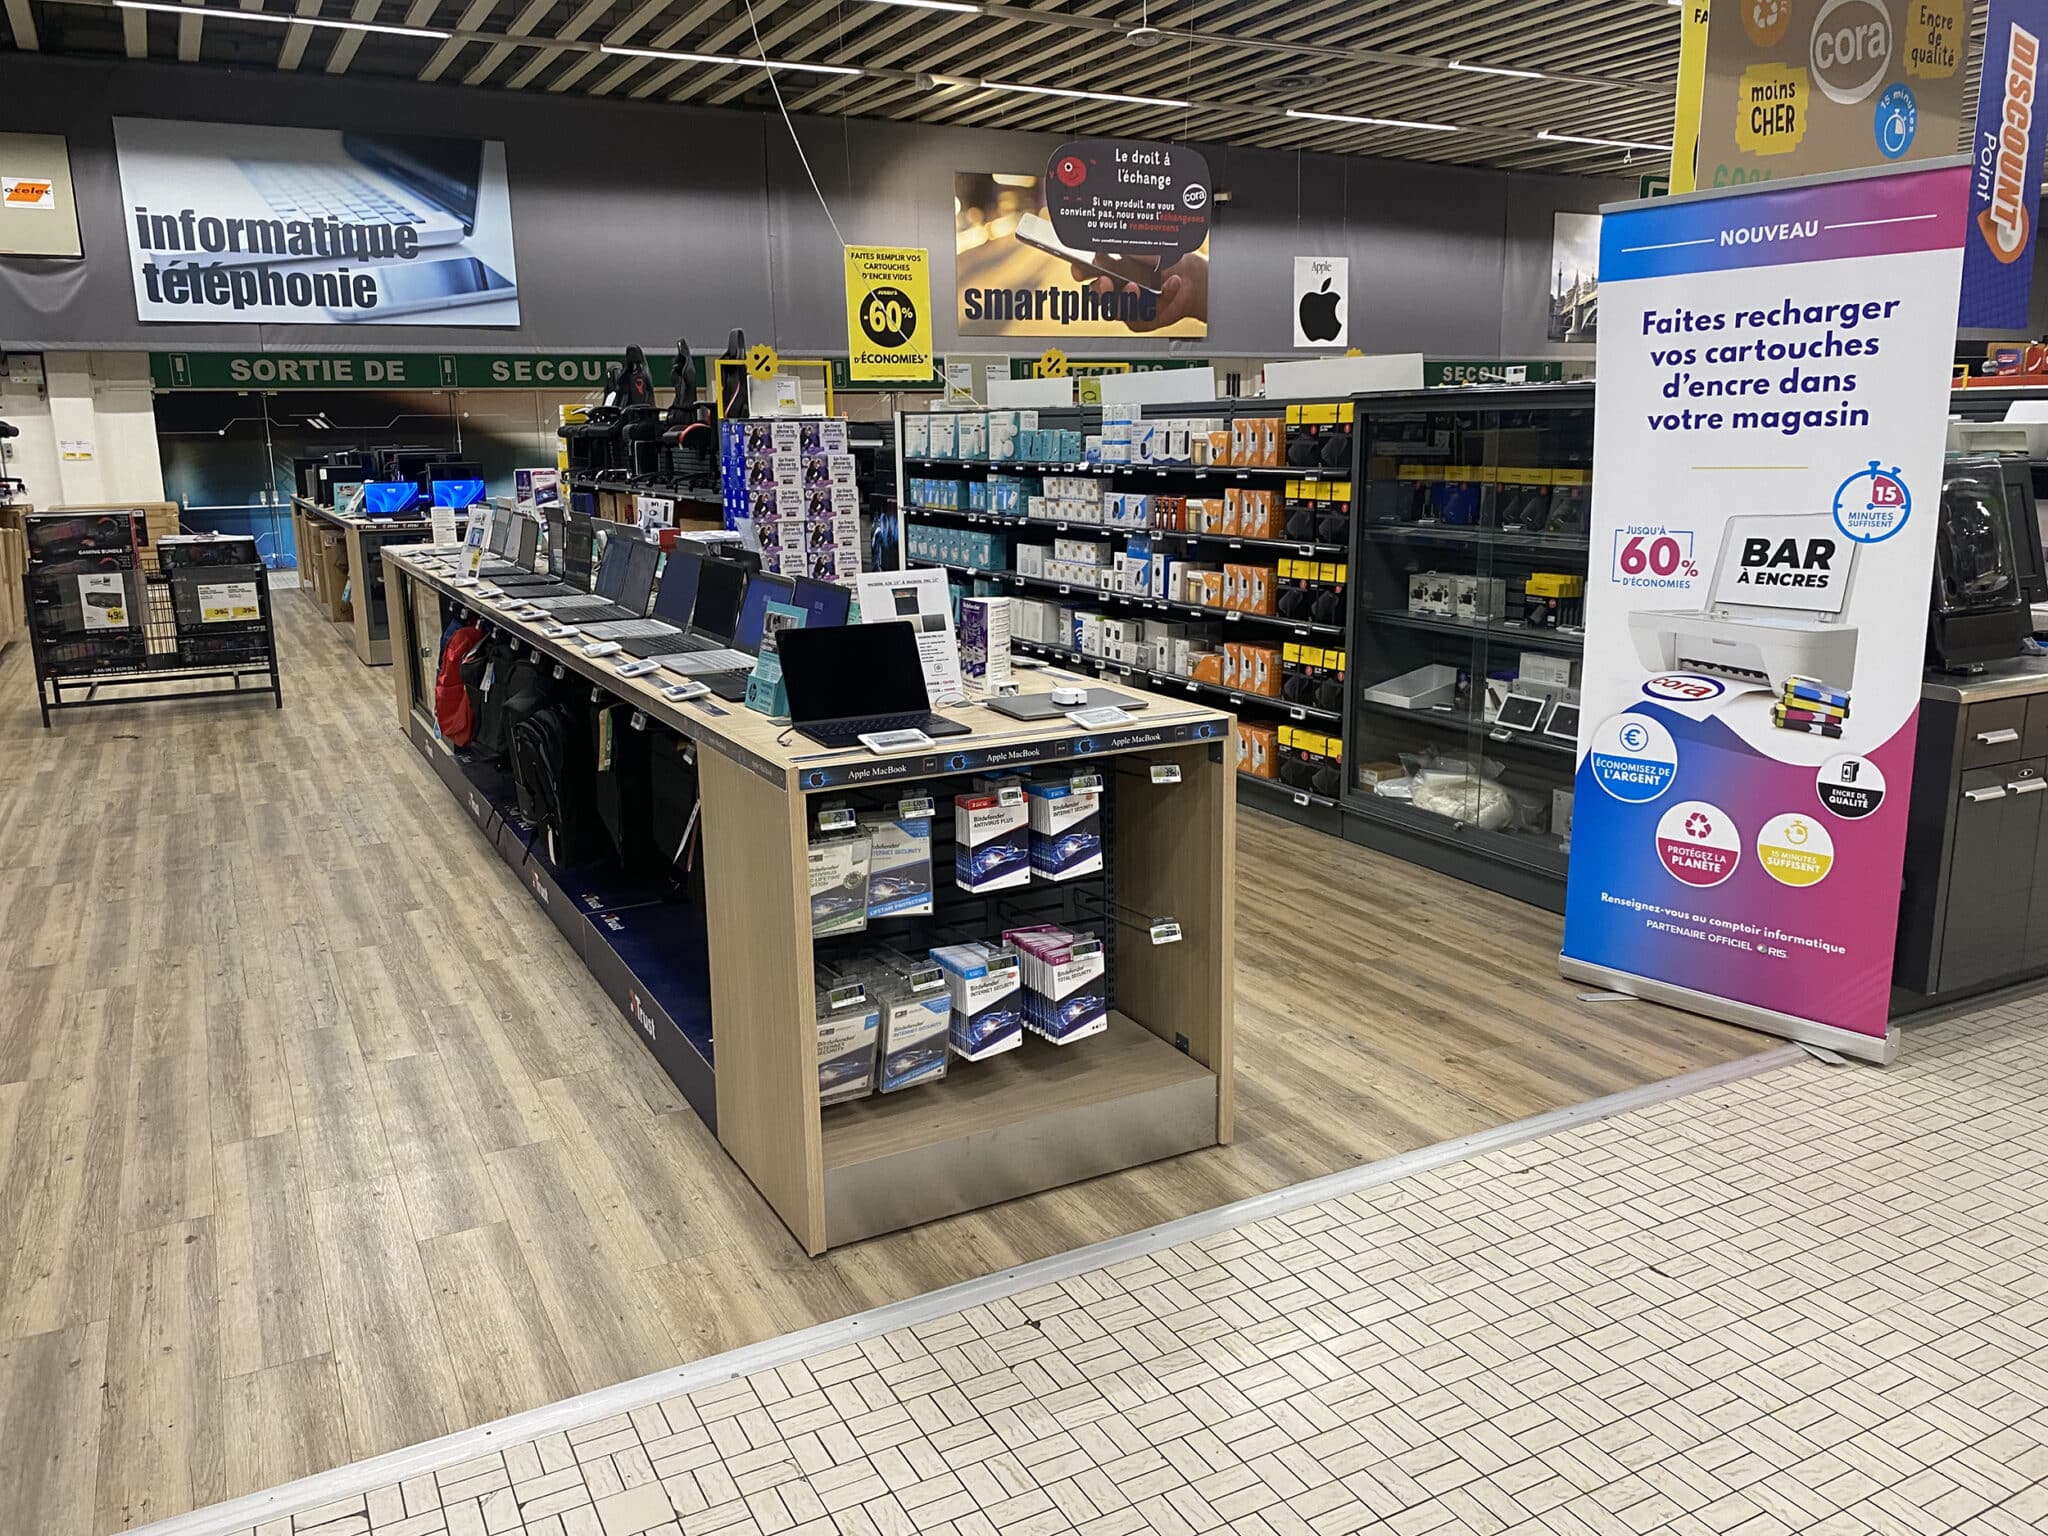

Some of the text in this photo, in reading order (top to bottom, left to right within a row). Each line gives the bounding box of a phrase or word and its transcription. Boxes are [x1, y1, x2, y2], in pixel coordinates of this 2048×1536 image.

[1919, 4, 1953, 30] Encre
[1814, 21, 1887, 69] cora
[1928, 27, 1942, 45] de
[1911, 44, 1955, 68] qualité
[1751, 80, 1796, 102] moins
[1751, 103, 1796, 136] CHER
[1993, 31, 2037, 232] DISCOUNT
[1115, 148, 1128, 162] Le
[1132, 149, 1161, 165] droit
[1976, 131, 1997, 201] Point
[1117, 169, 1172, 190] l'échange
[1092, 196, 1175, 211] Si un produit ne vous
[1060, 207, 1096, 217] convient
[1116, 210, 1134, 220] nous
[1136, 212, 1154, 221] vous
[1087, 220, 1098, 228] ou
[1099, 220, 1118, 229] vous
[1119, 220, 1127, 229] le
[1719, 220, 1819, 247] NOUVEAU
[135, 206, 420, 262] informatique
[851, 252, 921, 262] FAITES REMPLIR VOS
[863, 263, 910, 272] CARTOUCHES
[1311, 259, 1333, 274] Apple
[142, 261, 378, 311] téléphonie
[892, 273, 913, 281] VIDES
[964, 284, 1158, 325] smartphone
[1641, 298, 1901, 336] Faites recharger
[1650, 330, 1881, 367] vos cartouches
[230, 358, 626, 381] SORTIE DE SECOU
[1442, 366, 1508, 382] SECOU
[1662, 366, 1857, 399] d'encre dans
[1647, 401, 1870, 436] votre magasin
[1875, 485, 1897, 502] 15
[1847, 519, 1892, 528] SUFFISENT
[1848, 511, 1894, 521] MINUTES
[1625, 525, 1667, 536] JUSQU'À
[1619, 537, 1699, 577] 60%
[1740, 537, 1836, 570] BAR
[1622, 577, 1691, 589] D'ÉCONOMIES
[1737, 568, 1830, 588] À ENCRES
[1652, 678, 1713, 698] cora
[1111, 733, 1161, 746] Apple MacBook
[986, 748, 1041, 763] Apple MacBook
[847, 764, 907, 780] Apple MacBook
[1596, 757, 1671, 777] ÉCONOMISEZ DE
[1604, 768, 1660, 786] L'ARGENT
[1828, 795, 1869, 809] QUALITÉ
[1832, 788, 1867, 800] ENCRE DE
[973, 812, 1005, 822] Bitdefender
[973, 817, 1014, 829] ANTIVIRUS PLUS
[1667, 845, 1727, 864] PROTÉGEZ LA
[1770, 850, 1817, 864] 15 MINUTES
[1671, 855, 1721, 873] PLANÈTE
[1767, 857, 1821, 873] SUFFISENT
[1600, 891, 1846, 955] Renseignez-vous au comptoir informatique
[1646, 919, 1706, 941] PARTENAIRE
[1707, 932, 1753, 951] OFFICIEL
[634, 993, 656, 1041] Trust
